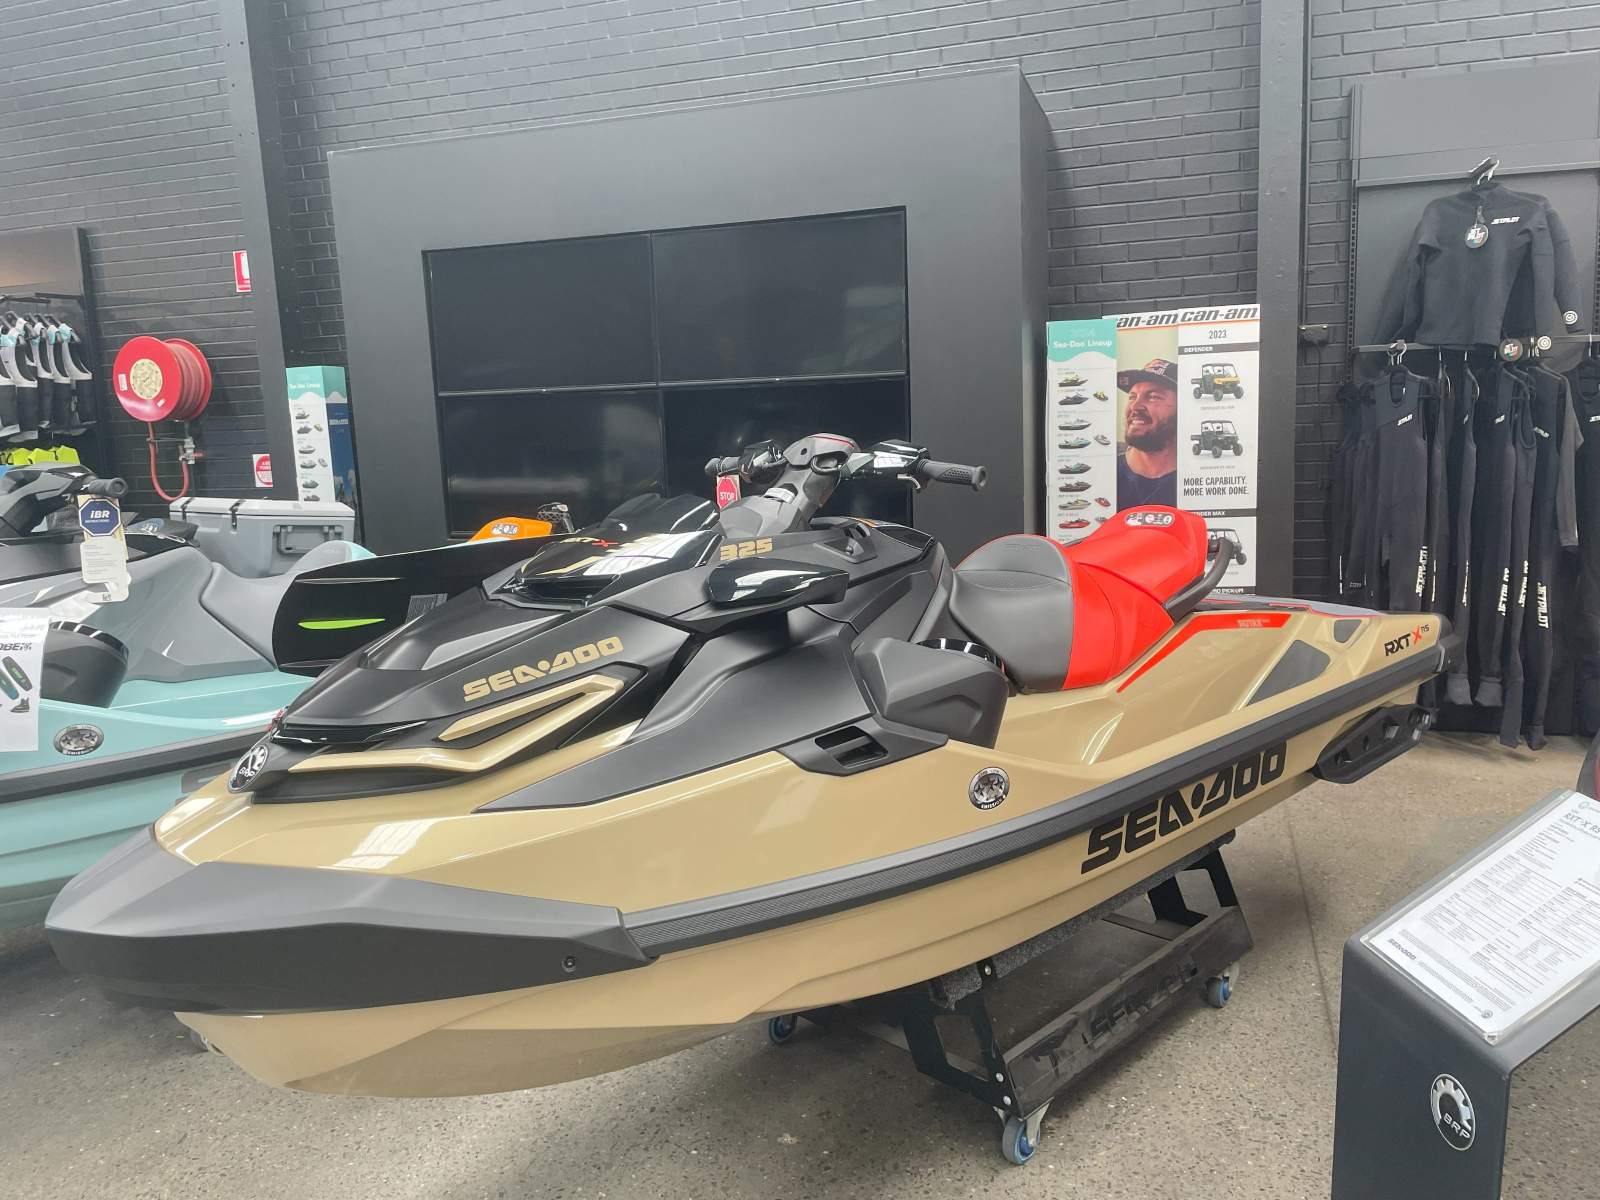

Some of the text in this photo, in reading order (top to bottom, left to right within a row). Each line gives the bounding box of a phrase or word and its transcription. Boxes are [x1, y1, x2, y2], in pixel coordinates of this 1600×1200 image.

[1116, 313, 1178, 328] an-am
[1180, 307, 1258, 323] can-am
[1208, 329, 1227, 339] 2023
[1183, 475, 1248, 487] MORE CAPABILITY.
[720, 491, 735, 500] STOP
[1183, 487, 1203, 497] MORE
[1205, 486, 1227, 496] WORK
[720, 537, 773, 560] 325
[1384, 633, 1411, 657] RXT
[1443, 1112, 1471, 1139] BRP
